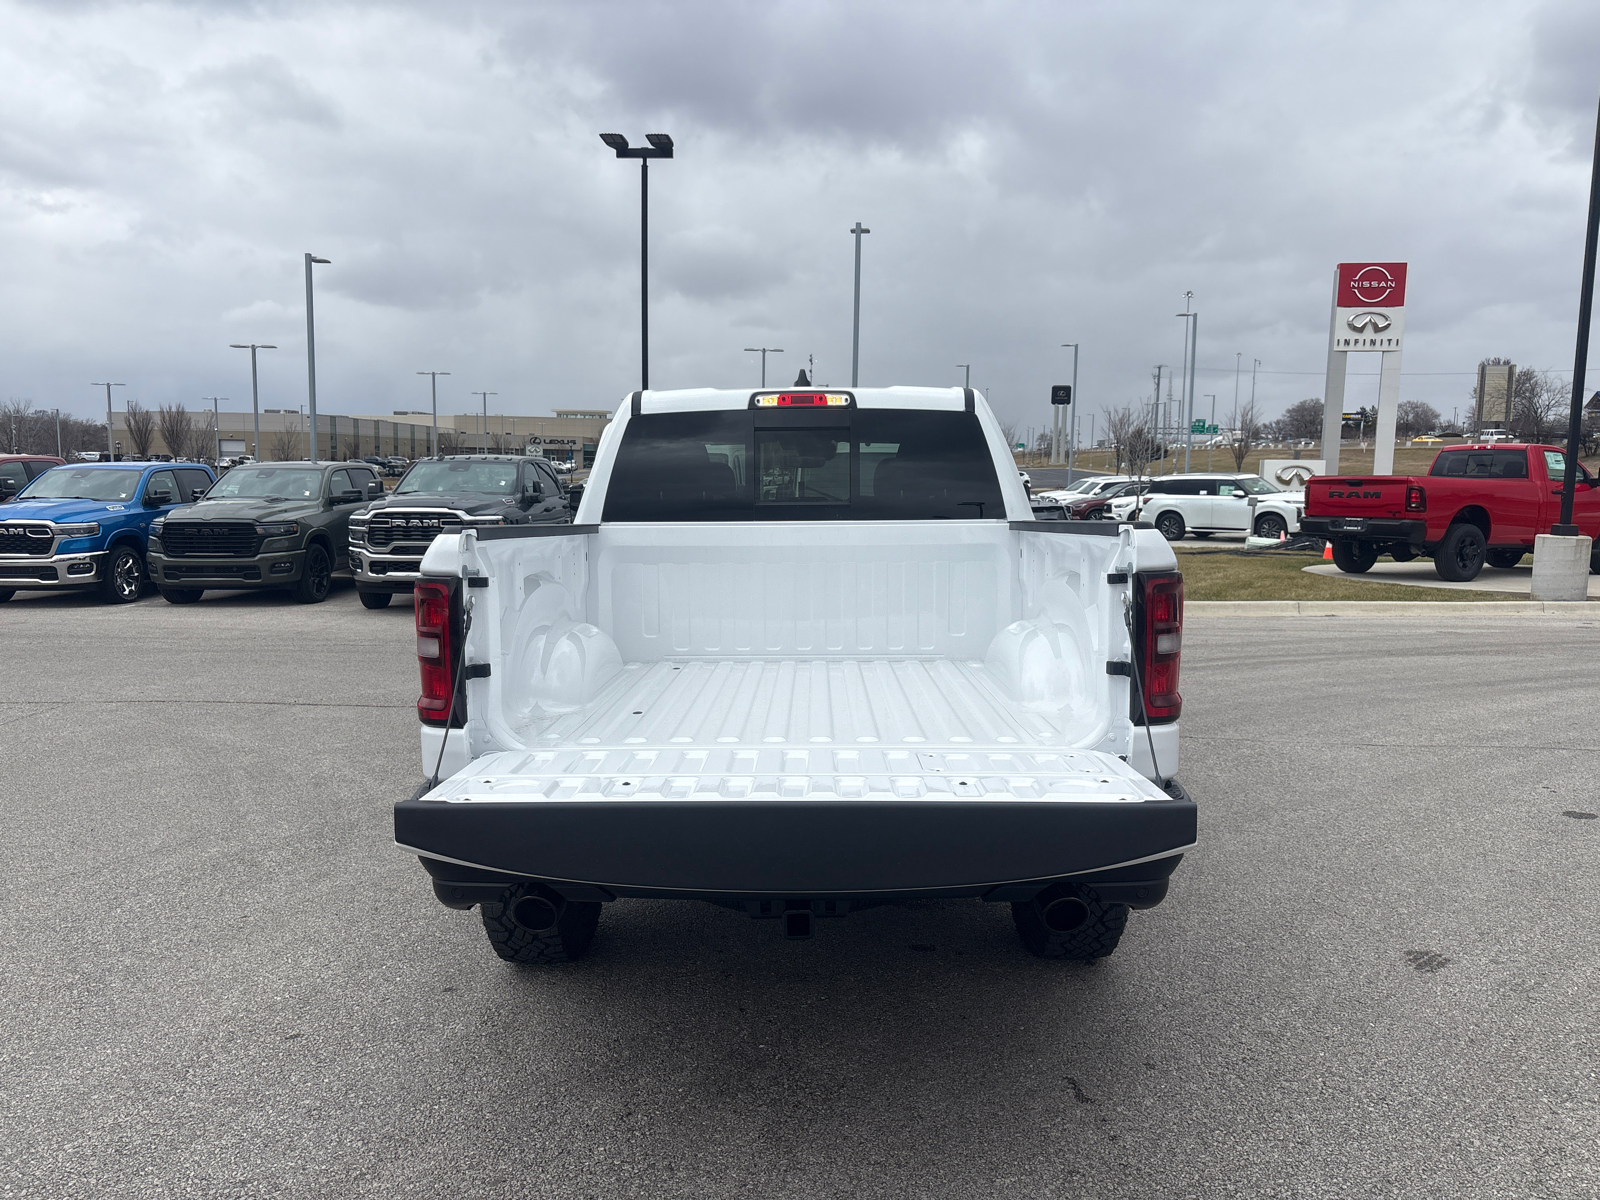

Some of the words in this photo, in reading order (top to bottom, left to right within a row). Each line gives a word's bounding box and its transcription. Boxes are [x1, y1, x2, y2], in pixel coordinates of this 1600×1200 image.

[1337, 338, 1399, 347] INFINITI
[1328, 491, 1381, 499] RAM
[391, 519, 439, 527] RAM
[184, 528, 229, 536] RAM
